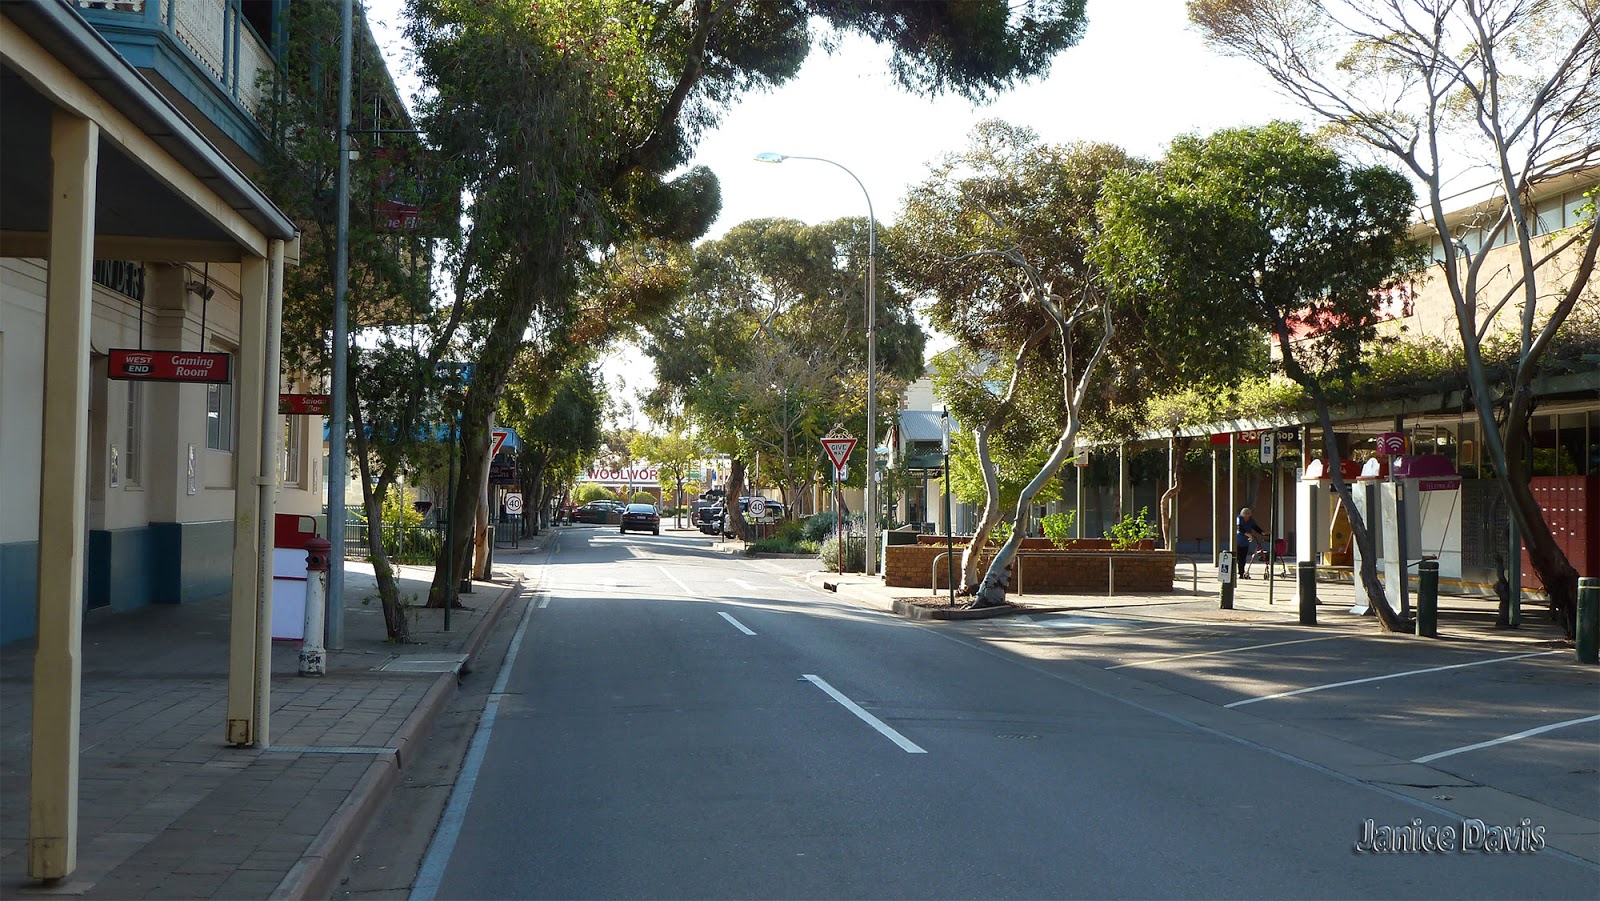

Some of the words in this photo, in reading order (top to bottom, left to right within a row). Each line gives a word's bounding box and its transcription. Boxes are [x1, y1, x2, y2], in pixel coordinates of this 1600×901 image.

[126, 355, 152, 364] WEST
[171, 355, 214, 369] Gaming
[128, 365, 149, 373] END
[176, 367, 209, 377] Room
[588, 469, 658, 480] WOOLWOR
[509, 499, 520, 508] 40
[752, 503, 763, 511] 40
